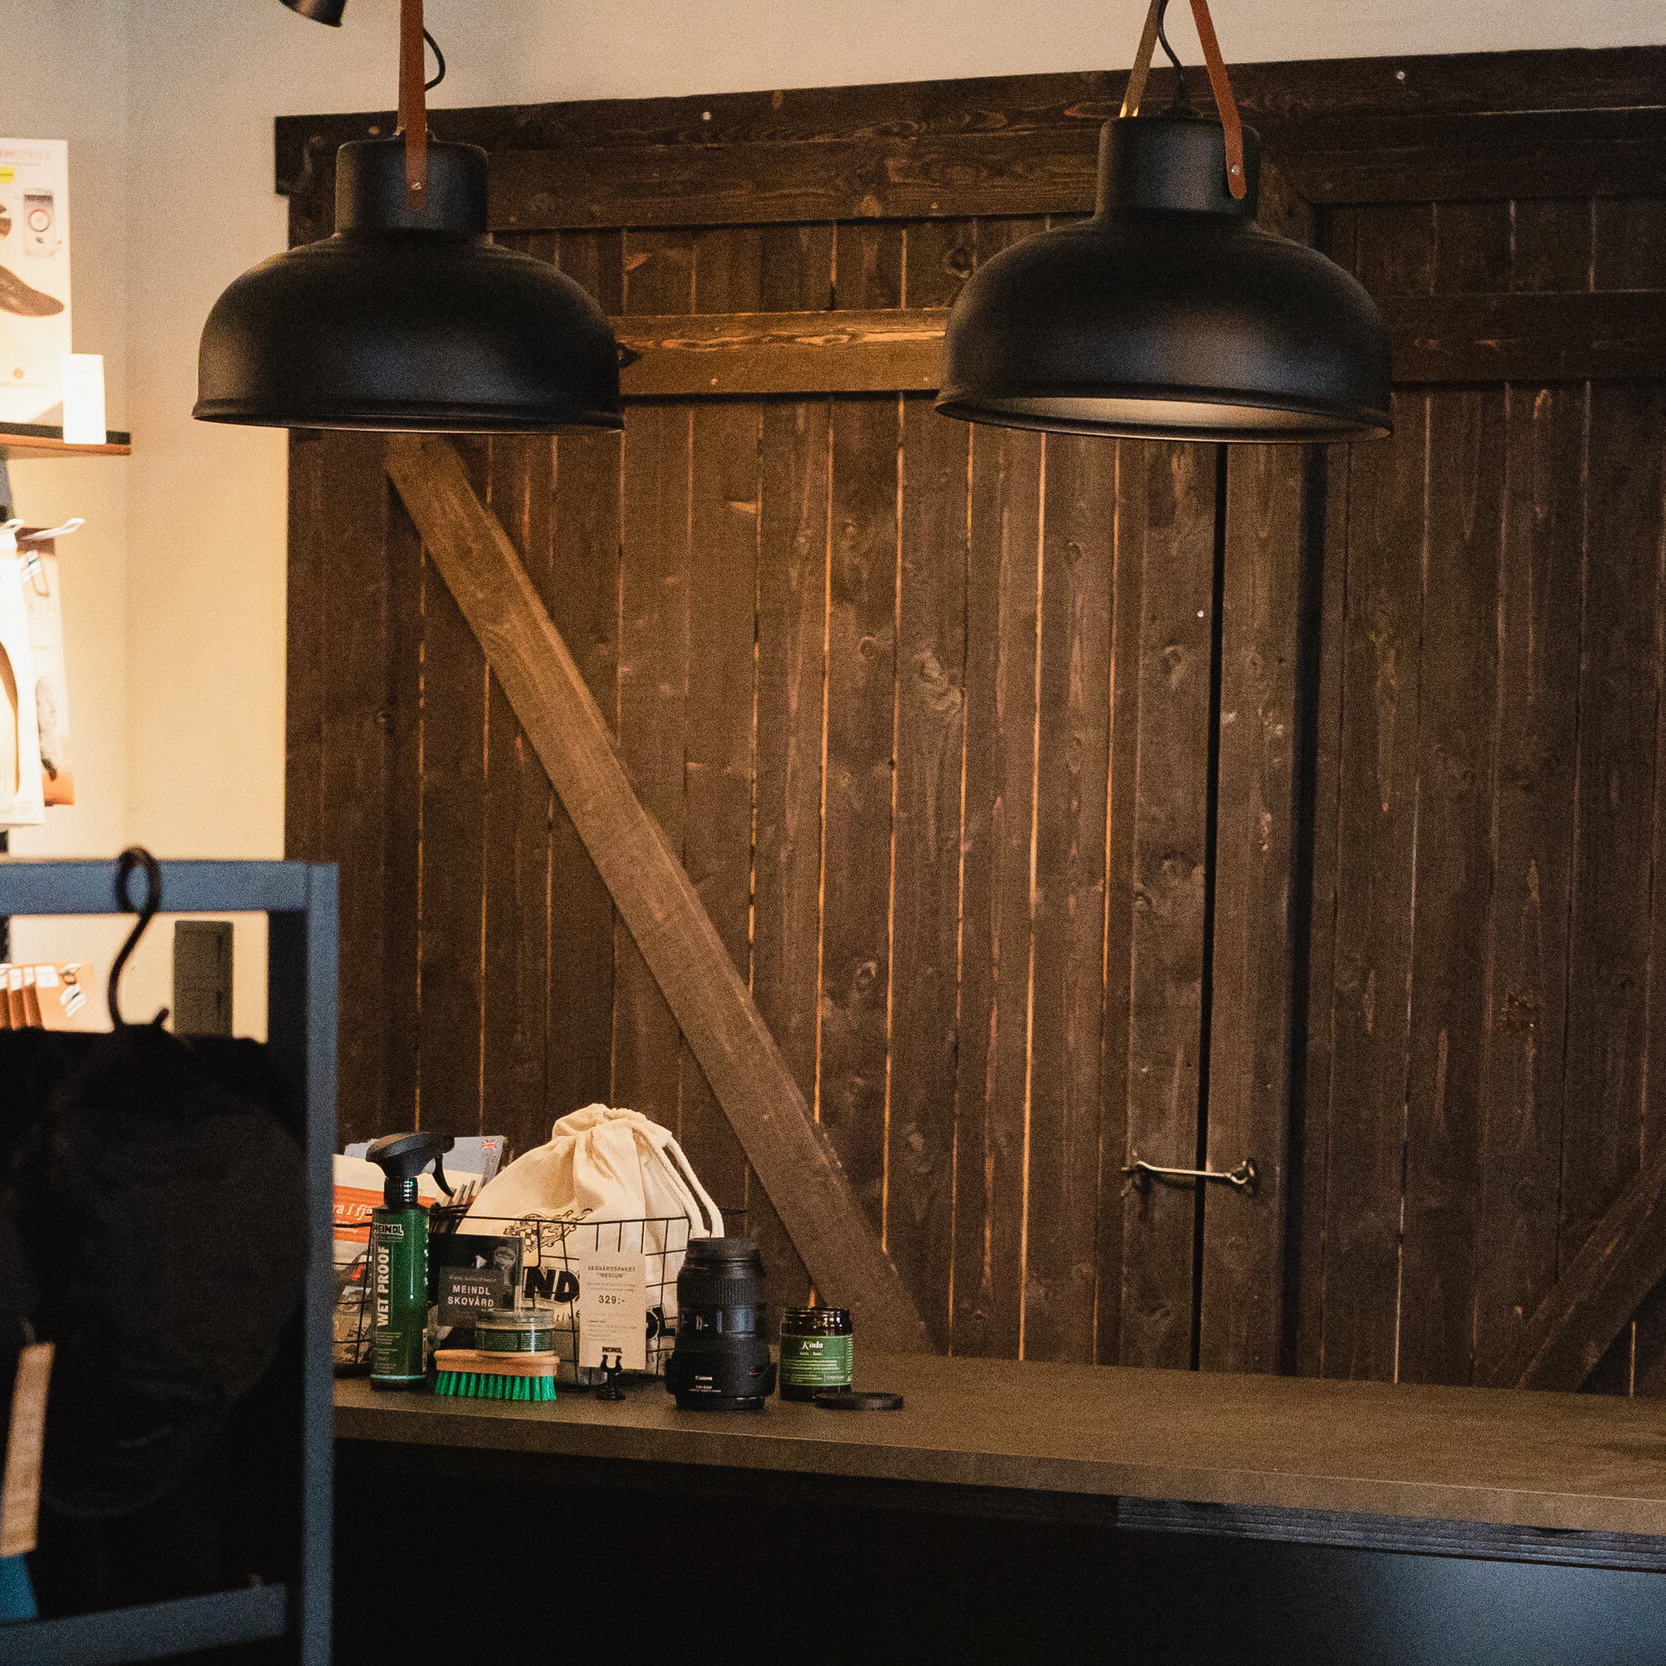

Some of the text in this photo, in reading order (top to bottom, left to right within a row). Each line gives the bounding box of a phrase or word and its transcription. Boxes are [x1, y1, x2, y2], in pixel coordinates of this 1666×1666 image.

[377, 1246, 390, 1293] PROOF
[452, 1285, 491, 1296] MEINDL
[447, 1296, 494, 1307] SKOVÅRD
[598, 1295, 625, 1304] 329:-
[377, 1298, 389, 1327] WET
